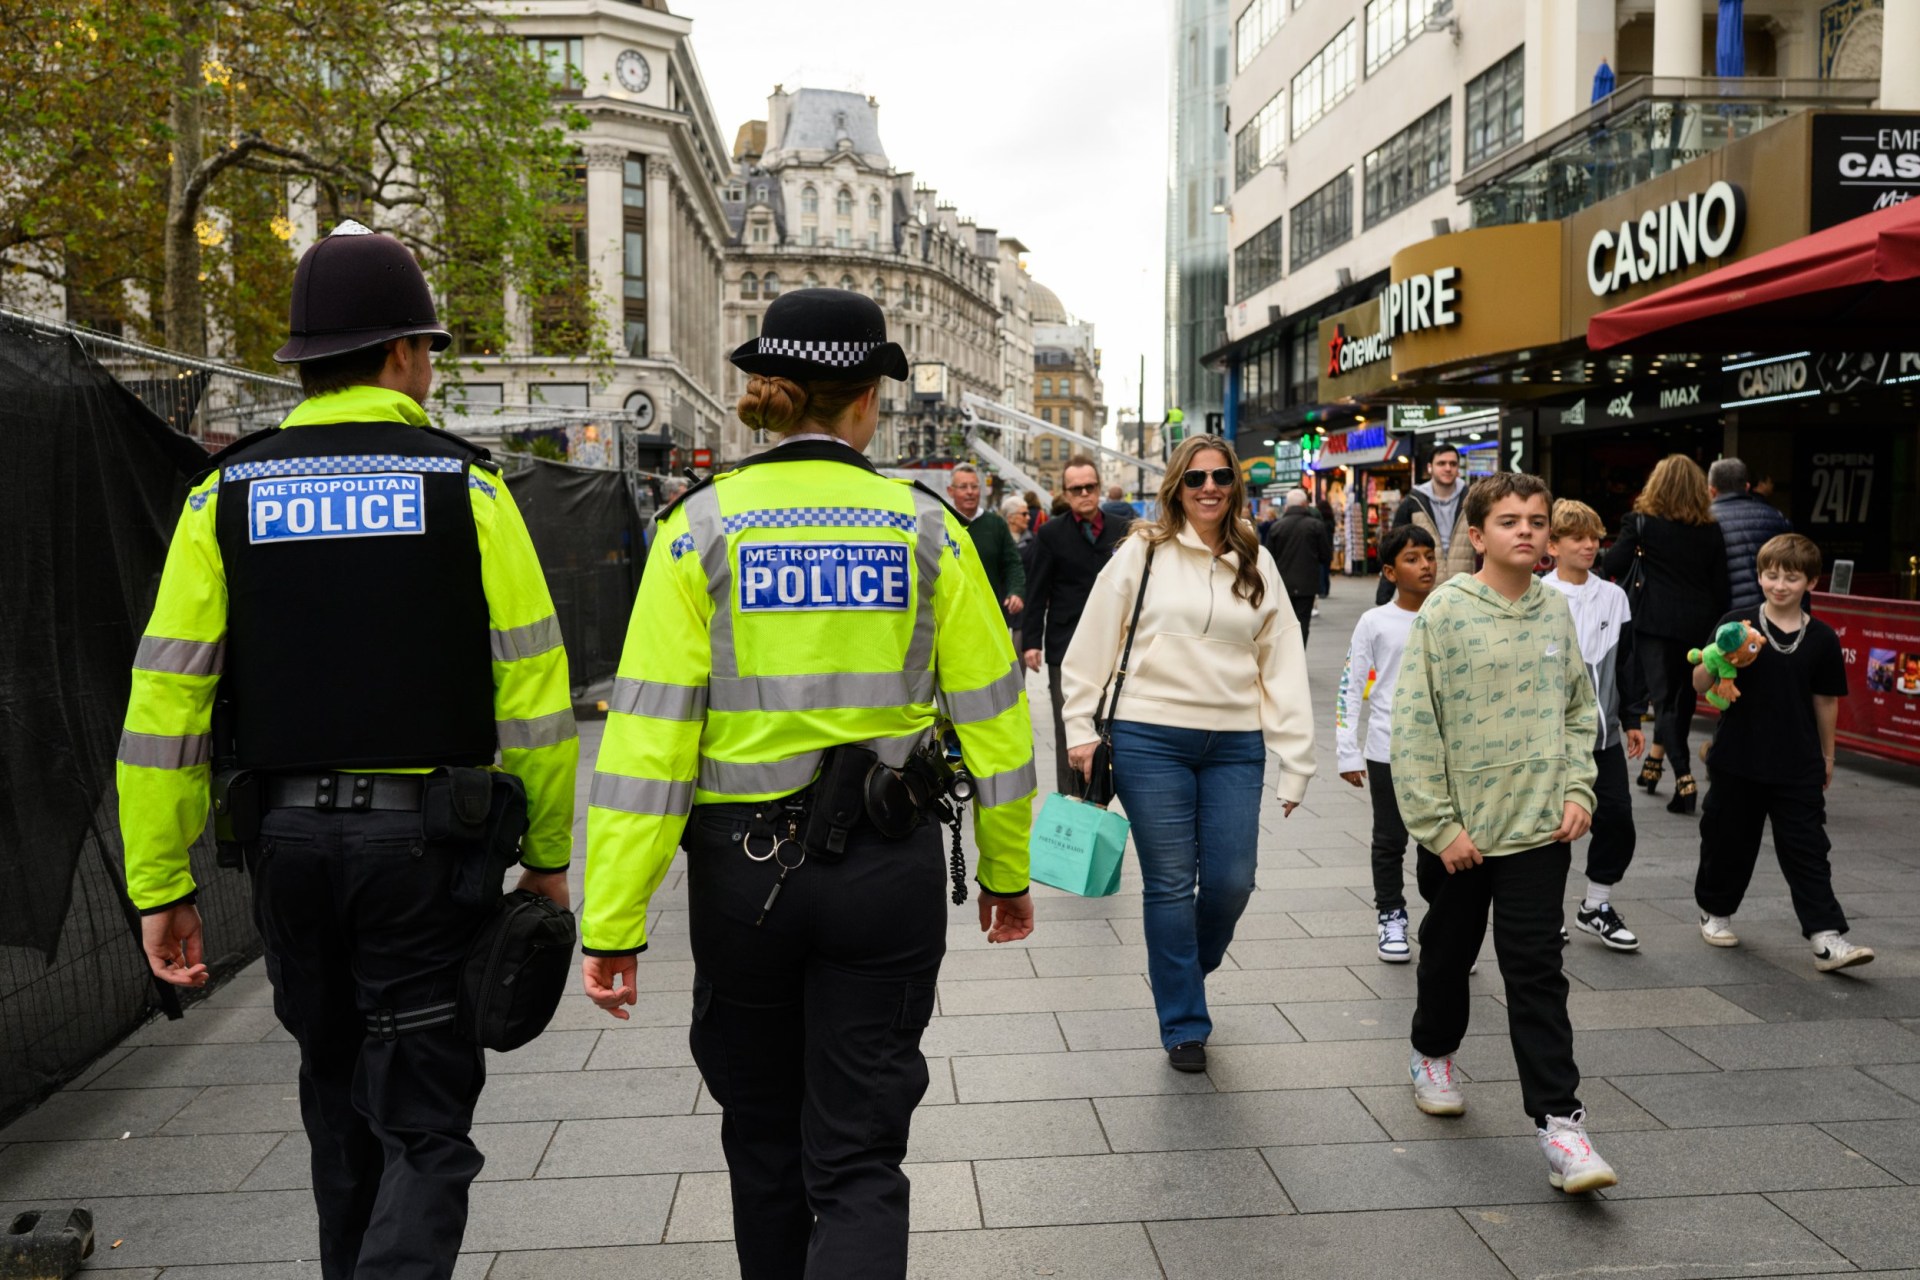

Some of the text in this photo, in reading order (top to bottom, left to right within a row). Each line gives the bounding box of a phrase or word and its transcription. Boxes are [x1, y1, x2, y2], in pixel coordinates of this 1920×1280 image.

[1838, 153, 1920, 178] CAS
[1587, 181, 1736, 297] CASINO
[1738, 360, 1807, 398] CASINO
[1660, 385, 1700, 409] IMAX
[1812, 453, 1875, 466] OPEN
[257, 479, 415, 497] METROPOLITAN
[1810, 468, 1874, 523] 24/7
[256, 494, 417, 536] POLICE
[746, 548, 903, 562] METROPOLITAN
[746, 565, 904, 604] POLICE
